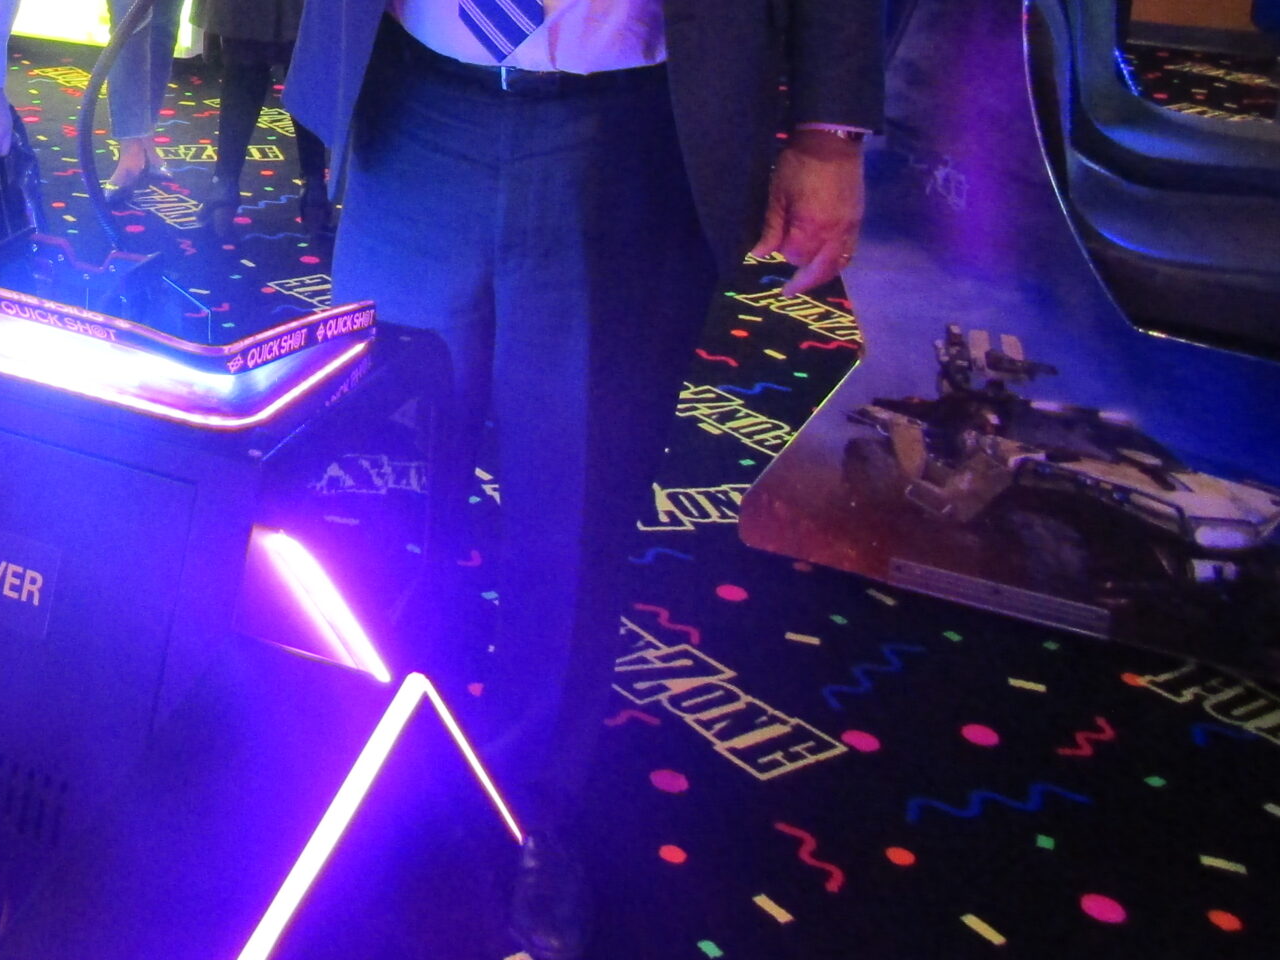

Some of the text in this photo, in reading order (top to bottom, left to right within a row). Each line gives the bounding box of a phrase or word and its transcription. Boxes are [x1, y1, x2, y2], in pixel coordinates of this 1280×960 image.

[1, 300, 117, 341] QUICK SHOT
[326, 309, 375, 338] QUICK SHOT
[247, 328, 307, 368] QUICK SHOT
